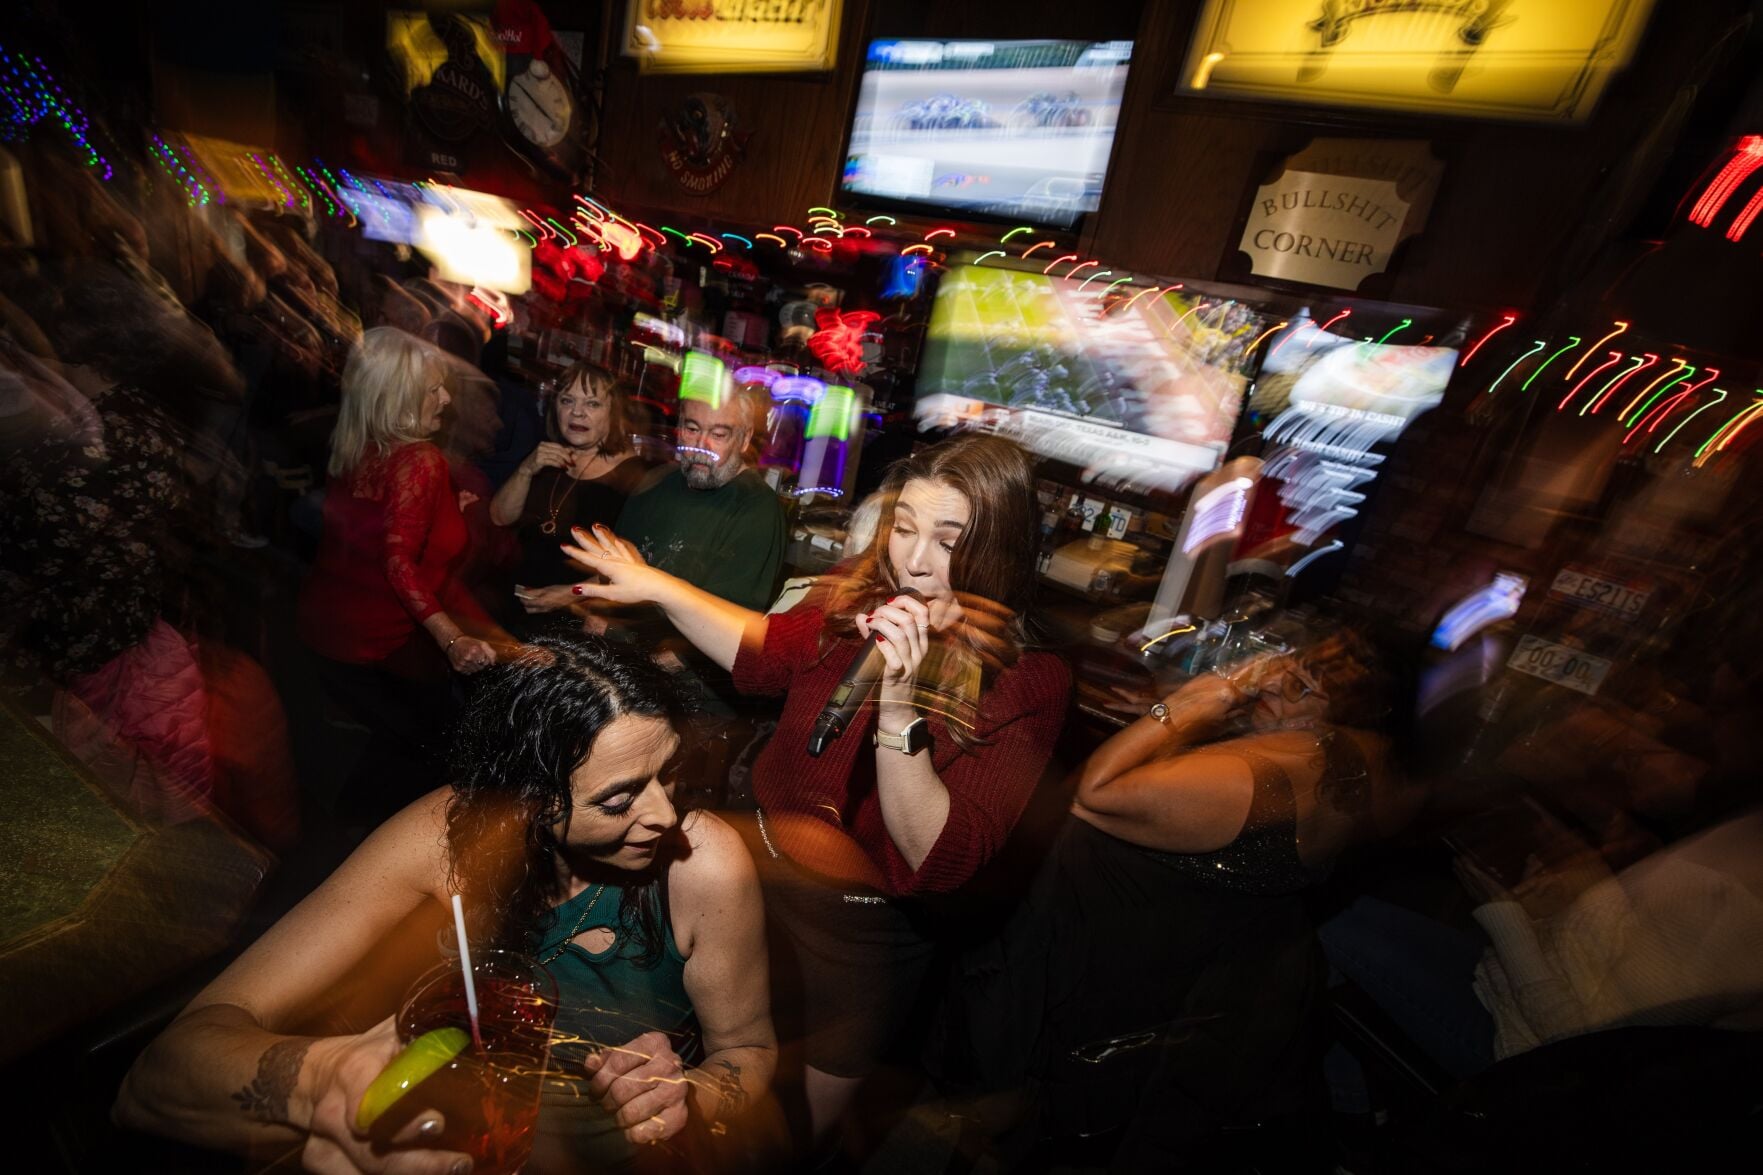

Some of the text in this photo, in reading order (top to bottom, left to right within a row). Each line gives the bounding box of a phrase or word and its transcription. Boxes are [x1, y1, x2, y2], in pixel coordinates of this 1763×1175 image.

[432, 152, 457, 167] RED
[680, 154, 734, 192] SMOKING
[1261, 190, 1397, 231] BULLSHIT
[1254, 229, 1374, 266] CORNER
[1077, 424, 1105, 437] TEXAS
